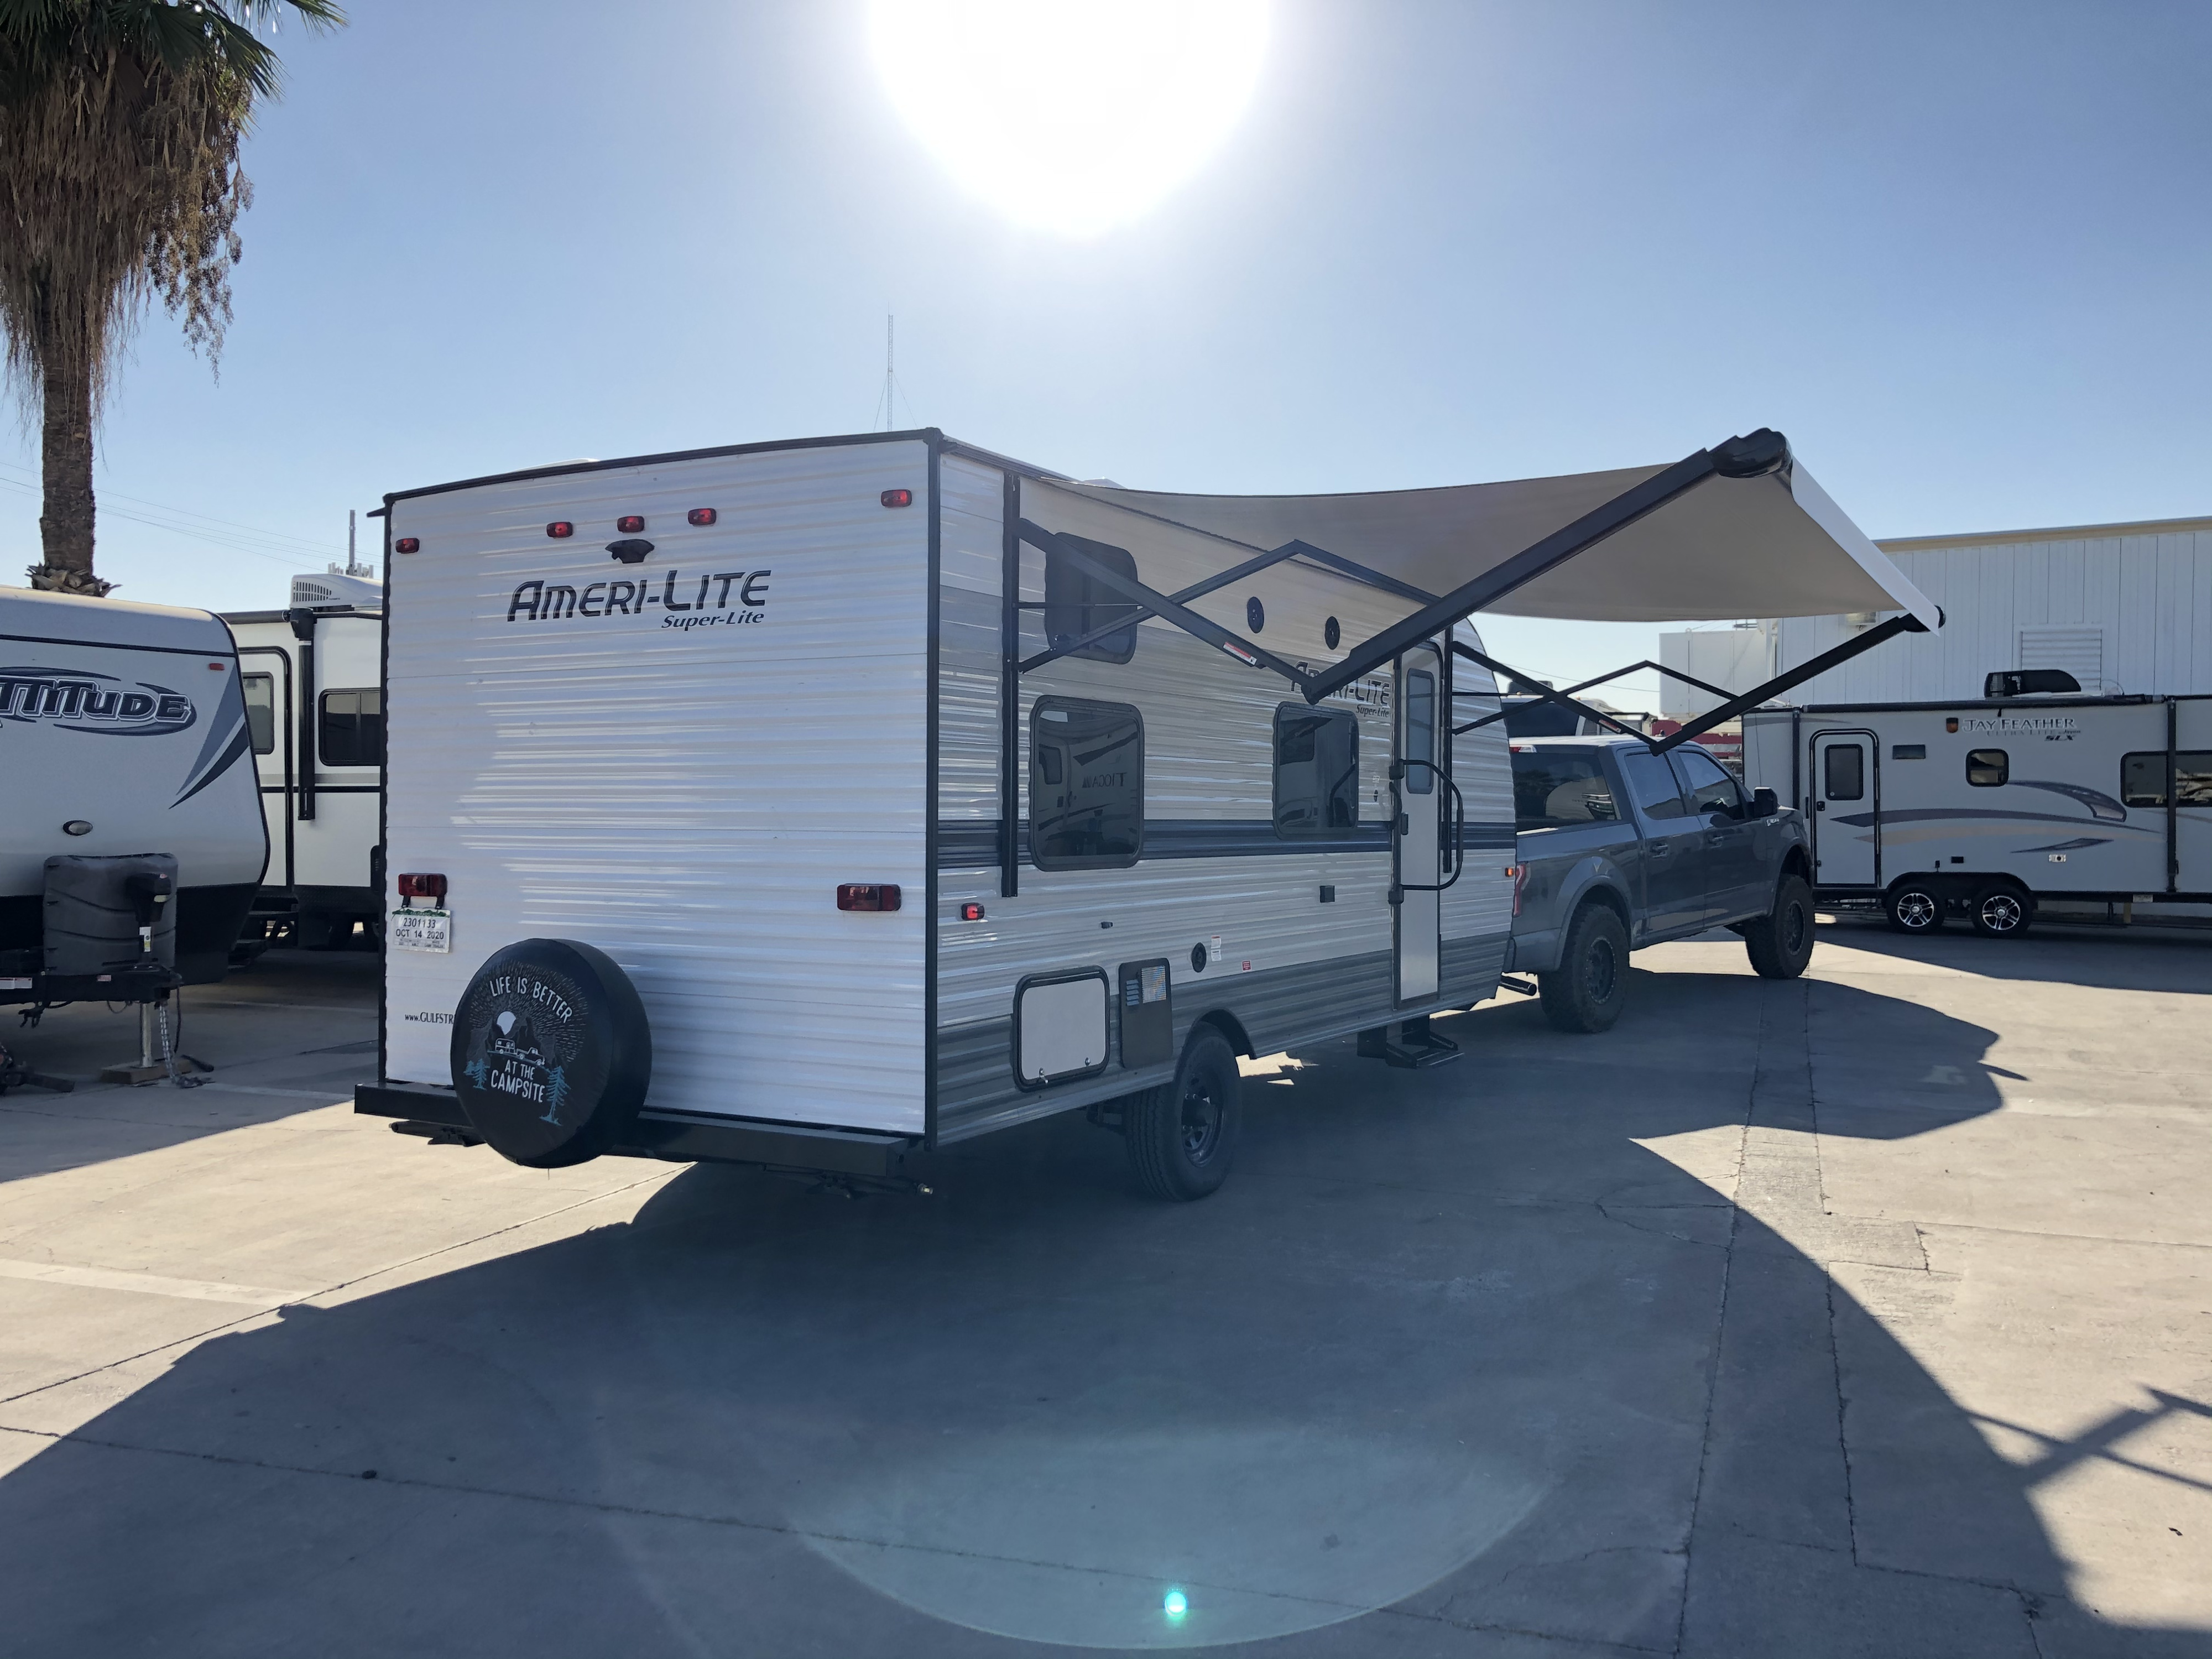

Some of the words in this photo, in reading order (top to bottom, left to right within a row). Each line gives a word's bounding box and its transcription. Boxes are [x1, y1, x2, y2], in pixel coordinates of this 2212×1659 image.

[661, 610, 764, 632] Super-Lite
[1356, 704, 1389, 718] Super-Lite
[1964, 719, 1996, 732] JAY
[2001, 718, 2076, 730] FEATHER
[427, 931, 444, 939] 2020
[490, 976, 511, 997] LIFE
[517, 977, 528, 994] IS
[533, 981, 573, 1024] BETTER
[504, 1060, 517, 1073] AT
[520, 1063, 536, 1080] THE
[491, 1070, 545, 1103] CAMPSITE
